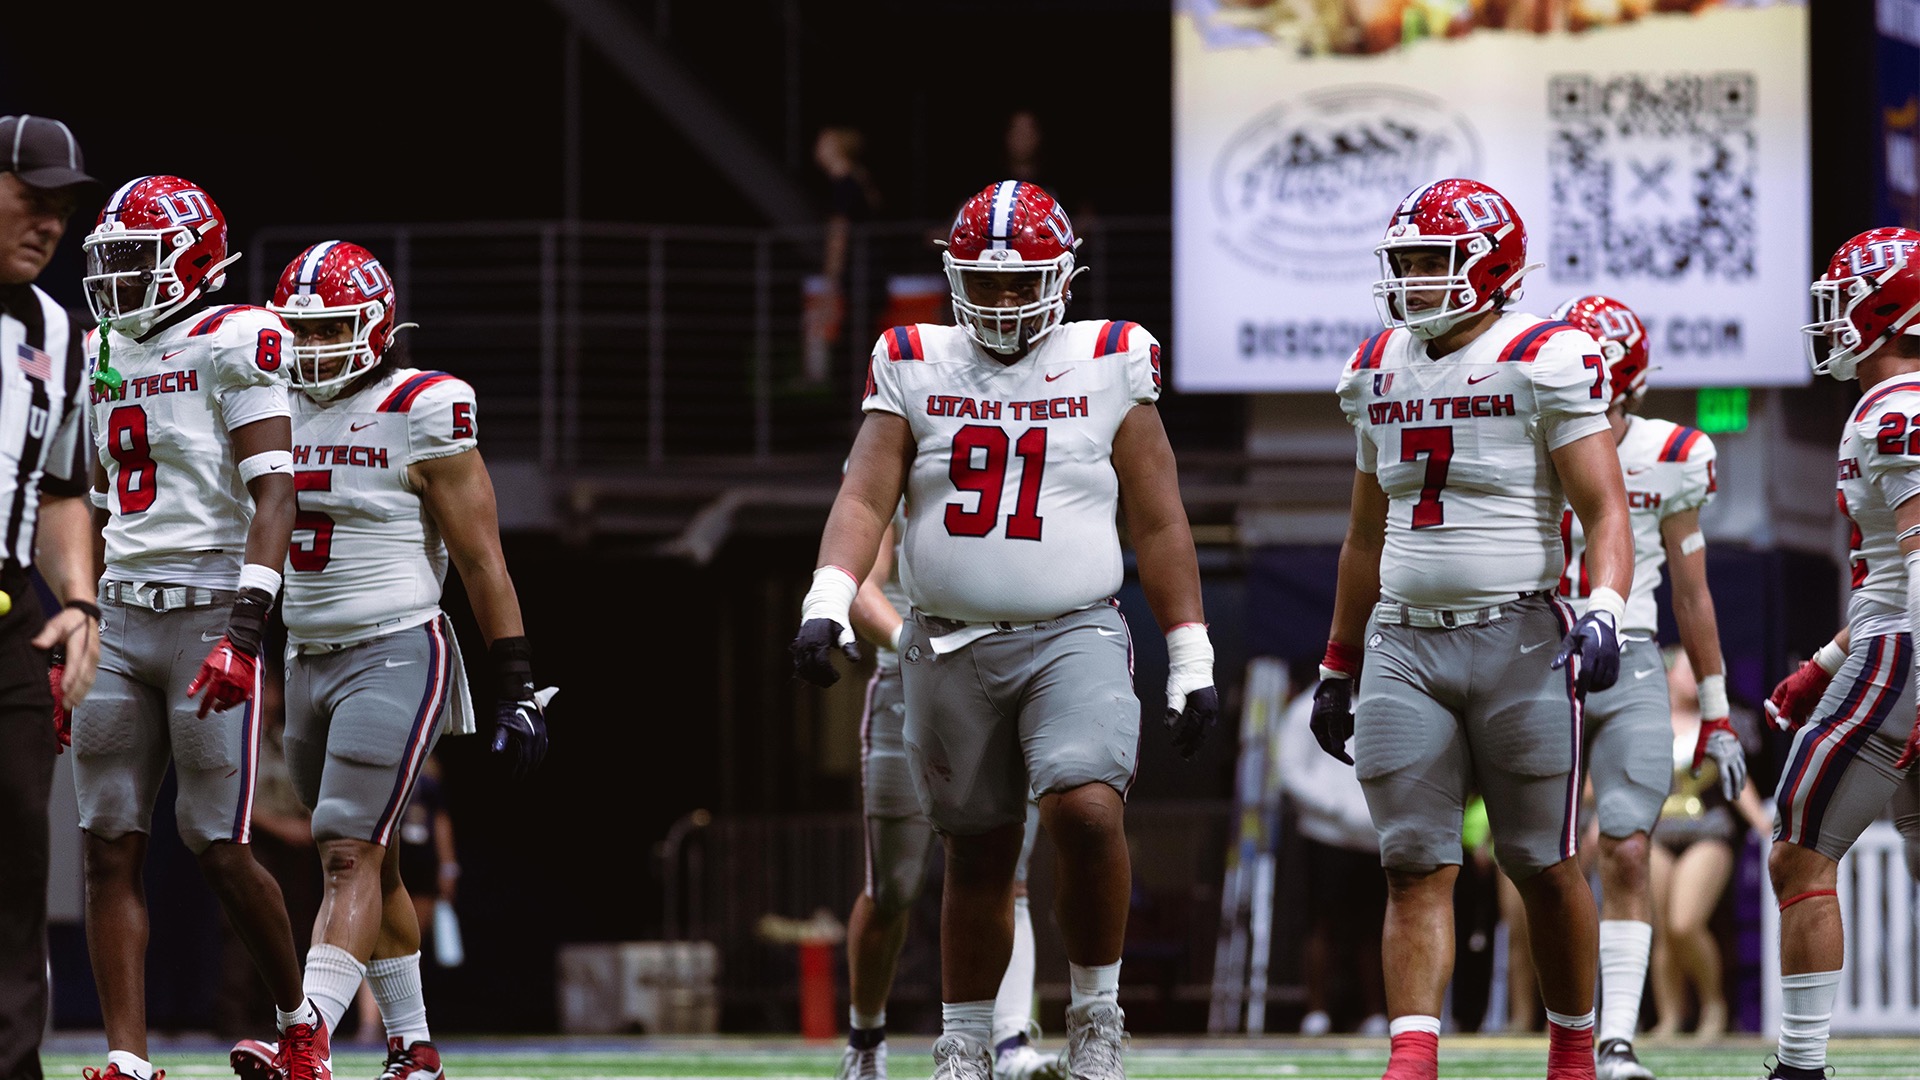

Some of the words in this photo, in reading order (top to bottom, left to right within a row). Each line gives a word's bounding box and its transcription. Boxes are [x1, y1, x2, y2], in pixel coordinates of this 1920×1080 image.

[157, 189, 214, 226] UT
[1454, 193, 1511, 230] UT
[255, 328, 283, 372] 8
[131, 370, 198, 398] TECH
[1582, 355, 1605, 399] 7
[30, 404, 48, 439] U
[453, 402, 474, 439] 5
[927, 395, 1002, 420] UTAH
[1008, 396, 1088, 420] TECH
[1367, 399, 1424, 425] UTAH
[1430, 394, 1516, 420] TECH
[108, 404, 157, 516] 8
[315, 445, 389, 469] TECH
[944, 424, 1047, 542] 91
[1400, 426, 1455, 530] 7
[289, 469, 336, 573] 5
